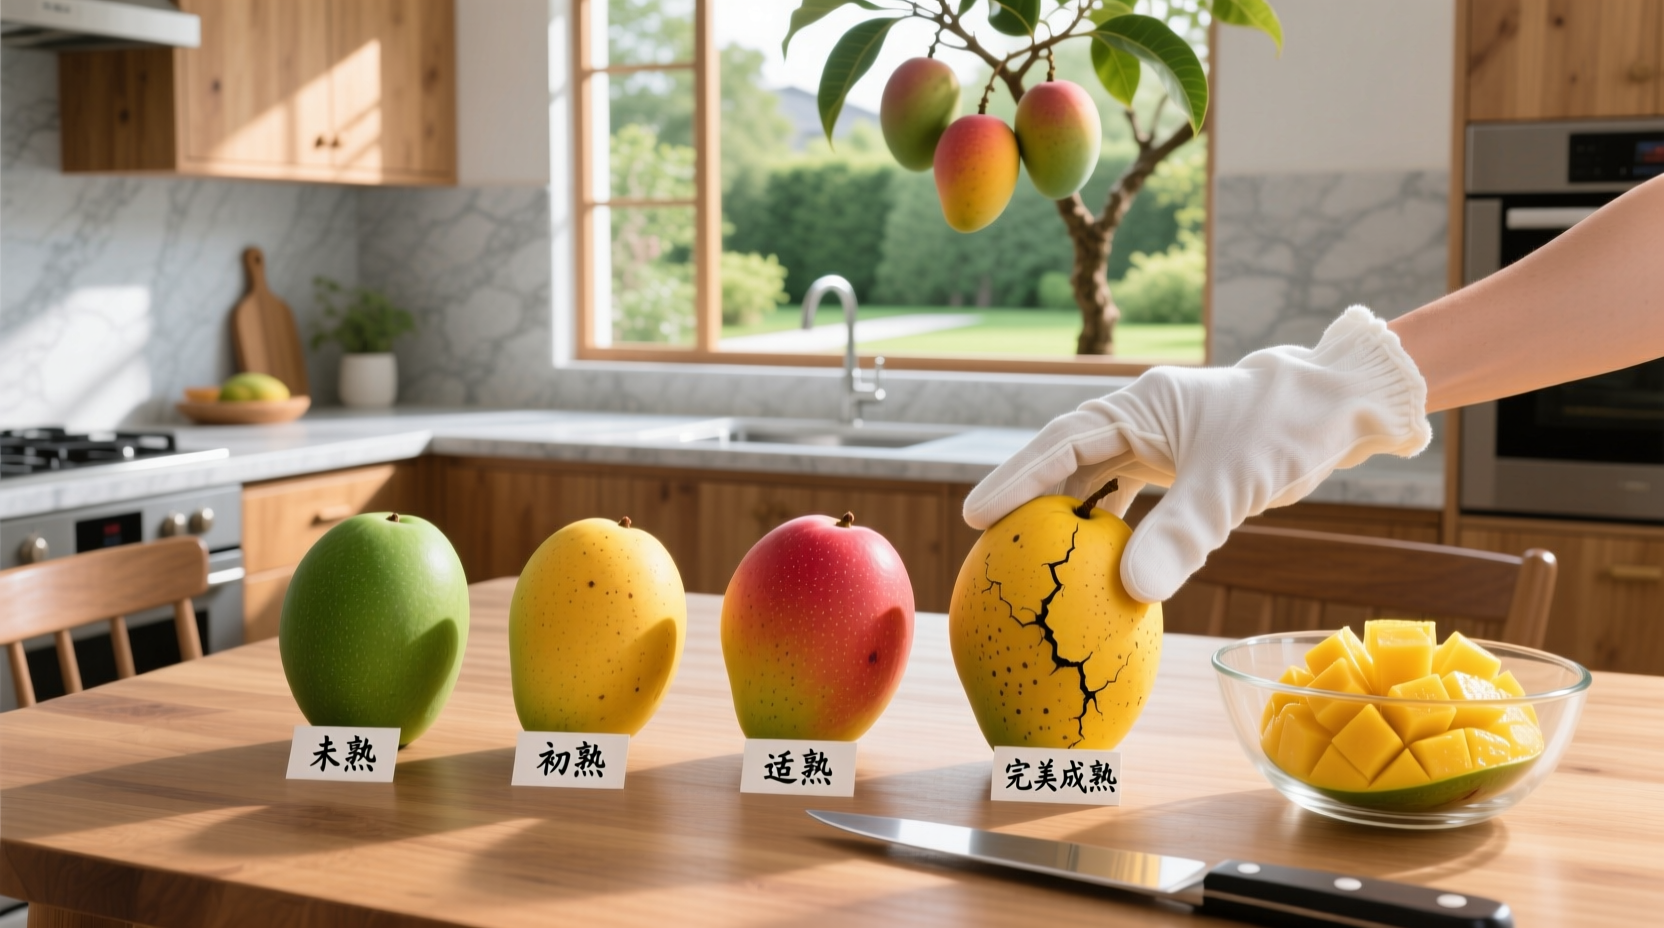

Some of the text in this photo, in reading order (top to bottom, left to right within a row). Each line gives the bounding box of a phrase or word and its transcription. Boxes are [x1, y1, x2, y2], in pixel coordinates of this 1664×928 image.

[309, 734, 377, 773] 未熟
[536, 740, 606, 778] 初熟
[763, 748, 833, 786] 适熟
[1005, 757, 1118, 794] 完美成熟
